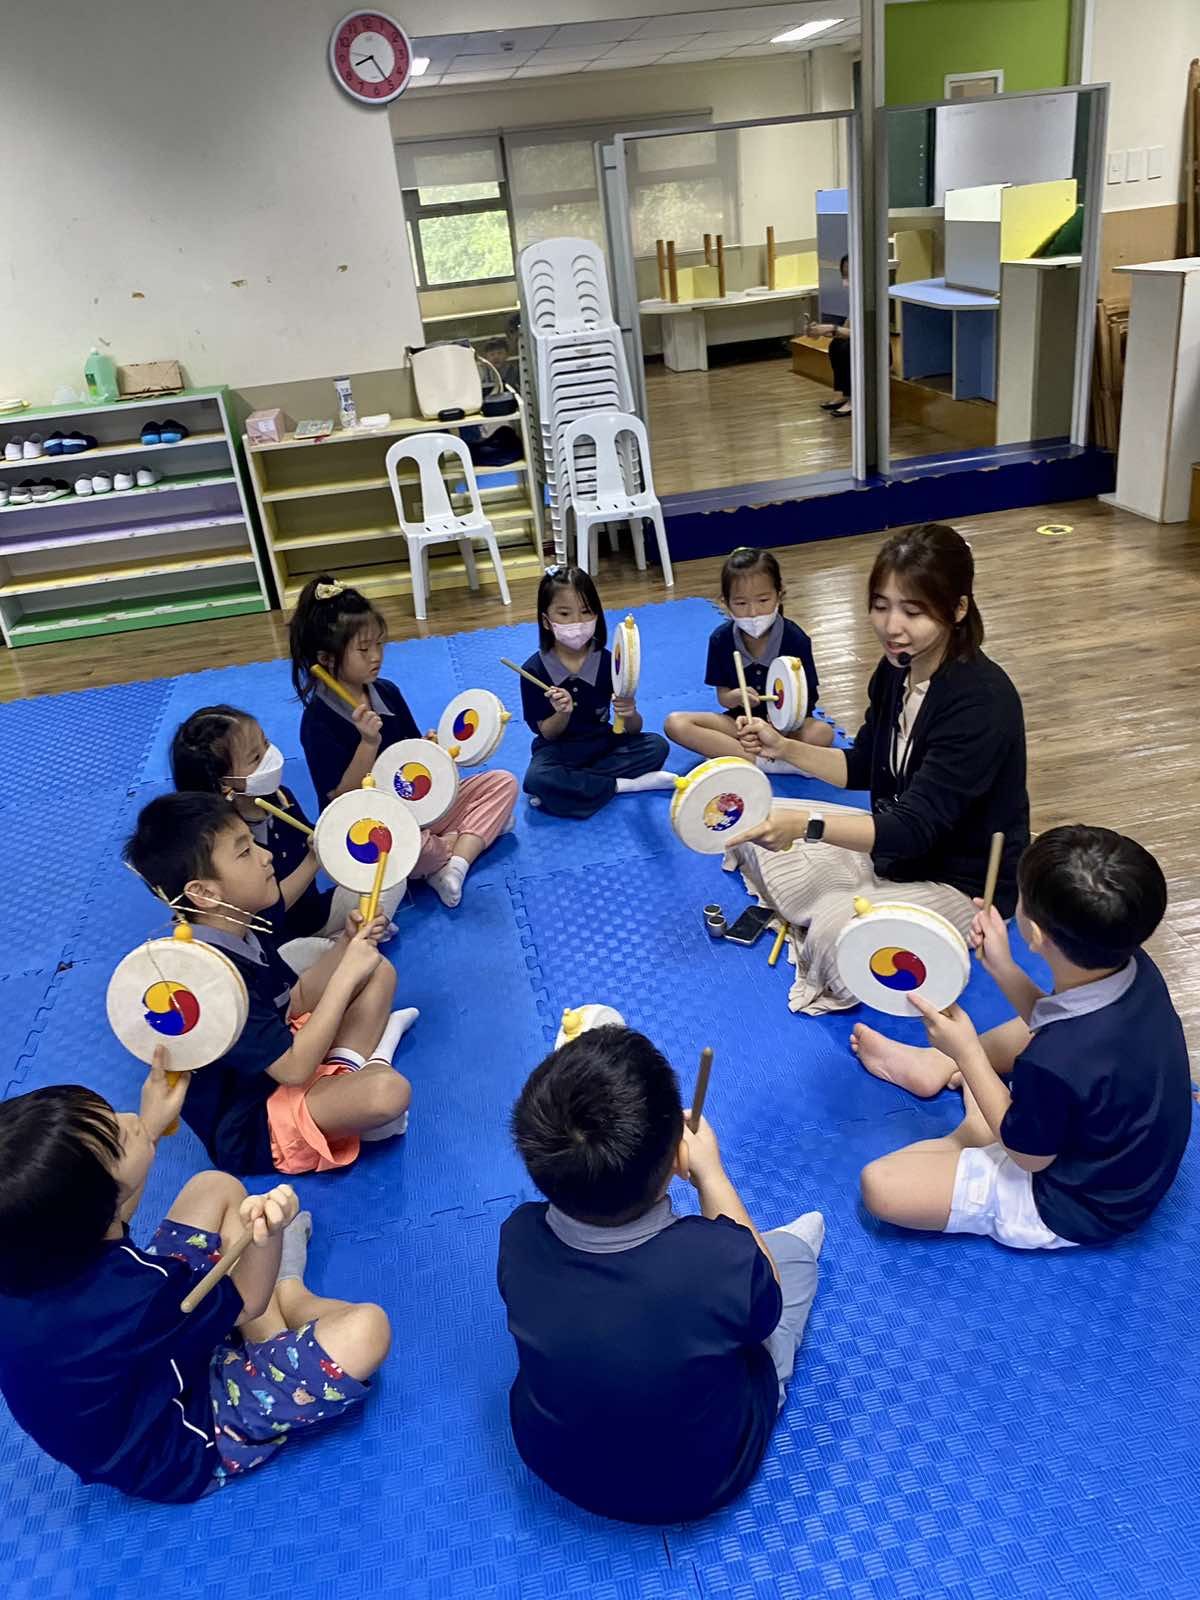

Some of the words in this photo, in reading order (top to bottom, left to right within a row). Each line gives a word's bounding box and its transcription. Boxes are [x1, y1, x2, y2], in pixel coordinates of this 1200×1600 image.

[392, 32, 399, 43] 2
[338, 54, 345, 64] 9
[398, 48, 404, 60] 3
[346, 71, 352, 80] 8
[396, 67, 403, 75] 4
[358, 82, 364, 92] 7
[388, 80, 394, 90] 5
[374, 87, 380, 96] 6
